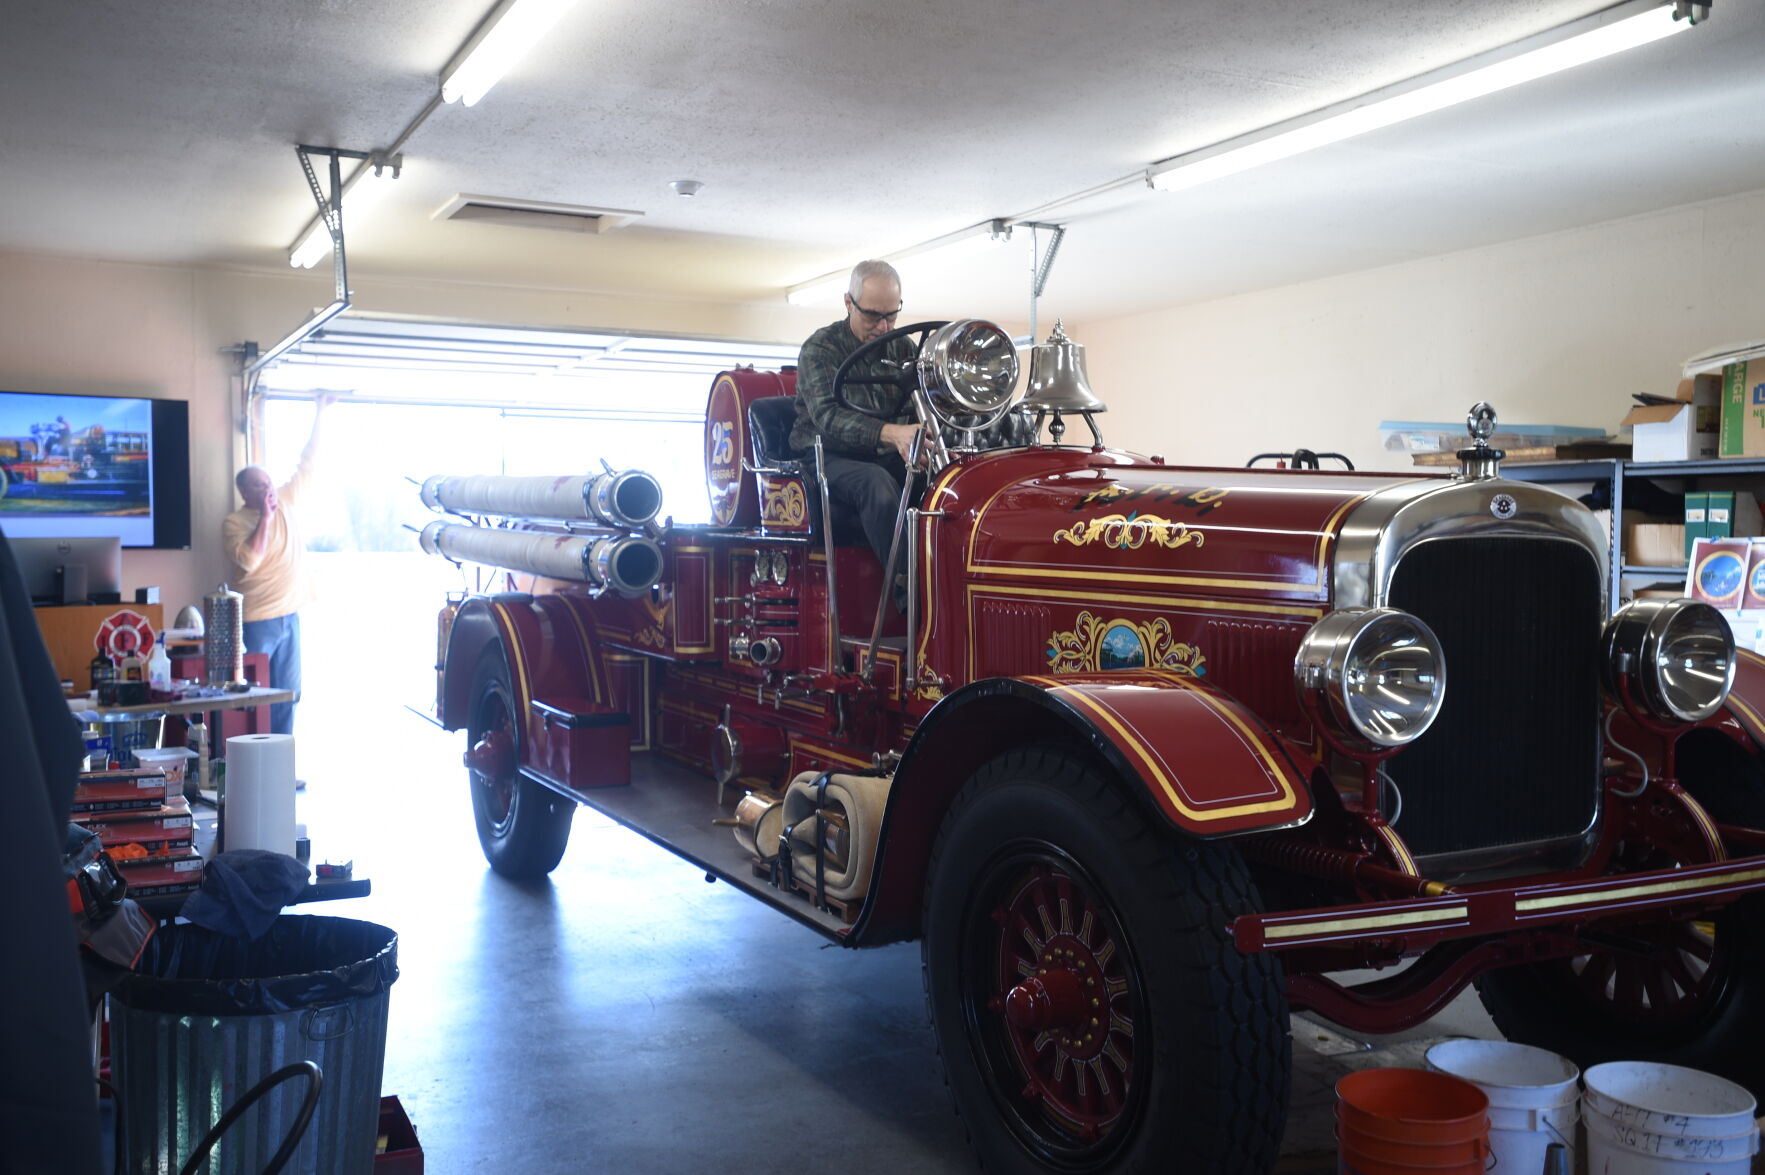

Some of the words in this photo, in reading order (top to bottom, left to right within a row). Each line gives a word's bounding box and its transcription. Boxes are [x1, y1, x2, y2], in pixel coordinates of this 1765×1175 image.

[1732, 362, 1745, 404] ARGE
[711, 420, 734, 465] 25
[711, 469, 735, 481] SEAGRAVE
